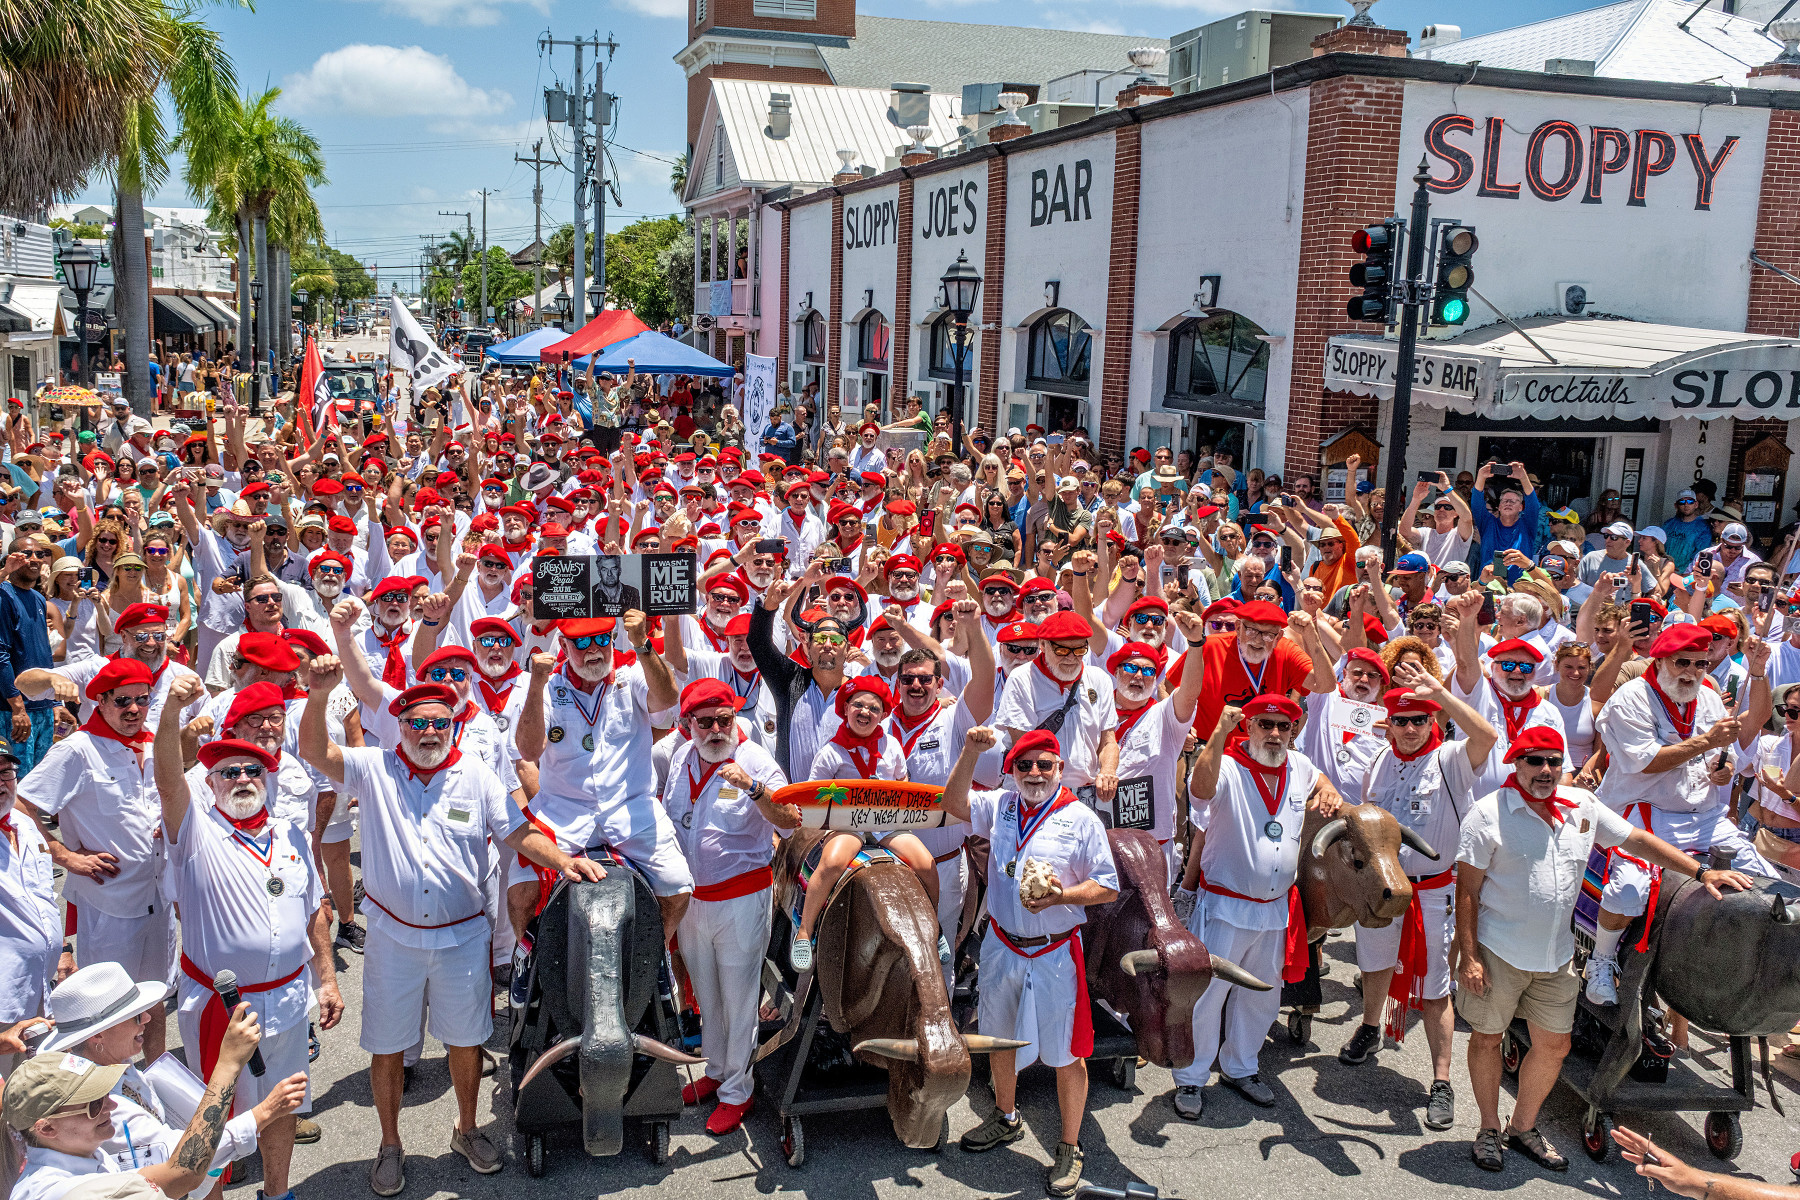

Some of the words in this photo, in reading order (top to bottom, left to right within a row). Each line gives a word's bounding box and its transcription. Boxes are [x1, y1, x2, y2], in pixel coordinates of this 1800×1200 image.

[1424, 114, 1740, 211] SLOPPY
[846, 198, 900, 250] SLOPPY
[922, 179, 978, 240] JOE'S
[1030, 159, 1092, 228] BAR
[1333, 348, 1387, 380] SLOPPY
[1391, 356, 1434, 386] E'S
[1441, 363, 1478, 392] BAR
[1525, 376, 1637, 405] Cocktails
[659, 559, 689, 567] WASN'T
[650, 566, 689, 585] ME
[650, 590, 689, 604] RUM
[1341, 699, 1360, 708] Running
[1125, 782, 1147, 791] WASN'T
[850, 788, 902, 808] HEMINGWAY
[906, 792, 932, 808] DAYS
[1118, 787, 1149, 809] ME
[850, 808, 872, 828] KEY
[873, 807, 900, 825] WEST
[903, 809, 929, 824] 2025
[1120, 808, 1149, 824] RUM
